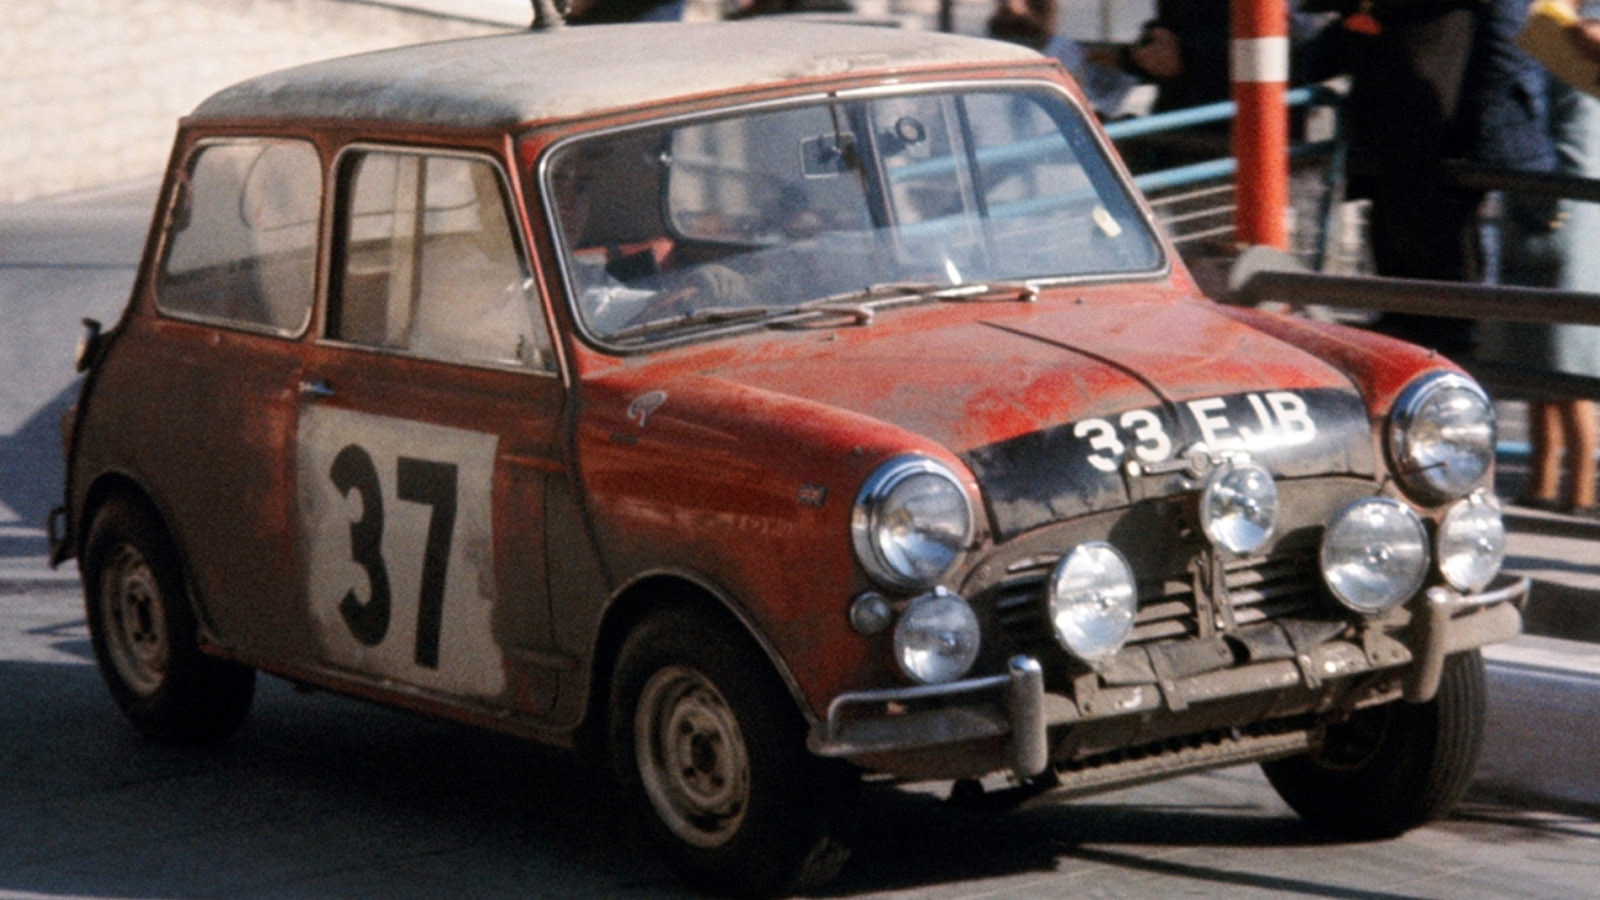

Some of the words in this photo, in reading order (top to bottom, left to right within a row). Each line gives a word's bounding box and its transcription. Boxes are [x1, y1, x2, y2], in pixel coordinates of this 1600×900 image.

[1073, 409, 1172, 472] 33
[1187, 391, 1318, 451] EJB
[330, 444, 458, 670] 37
